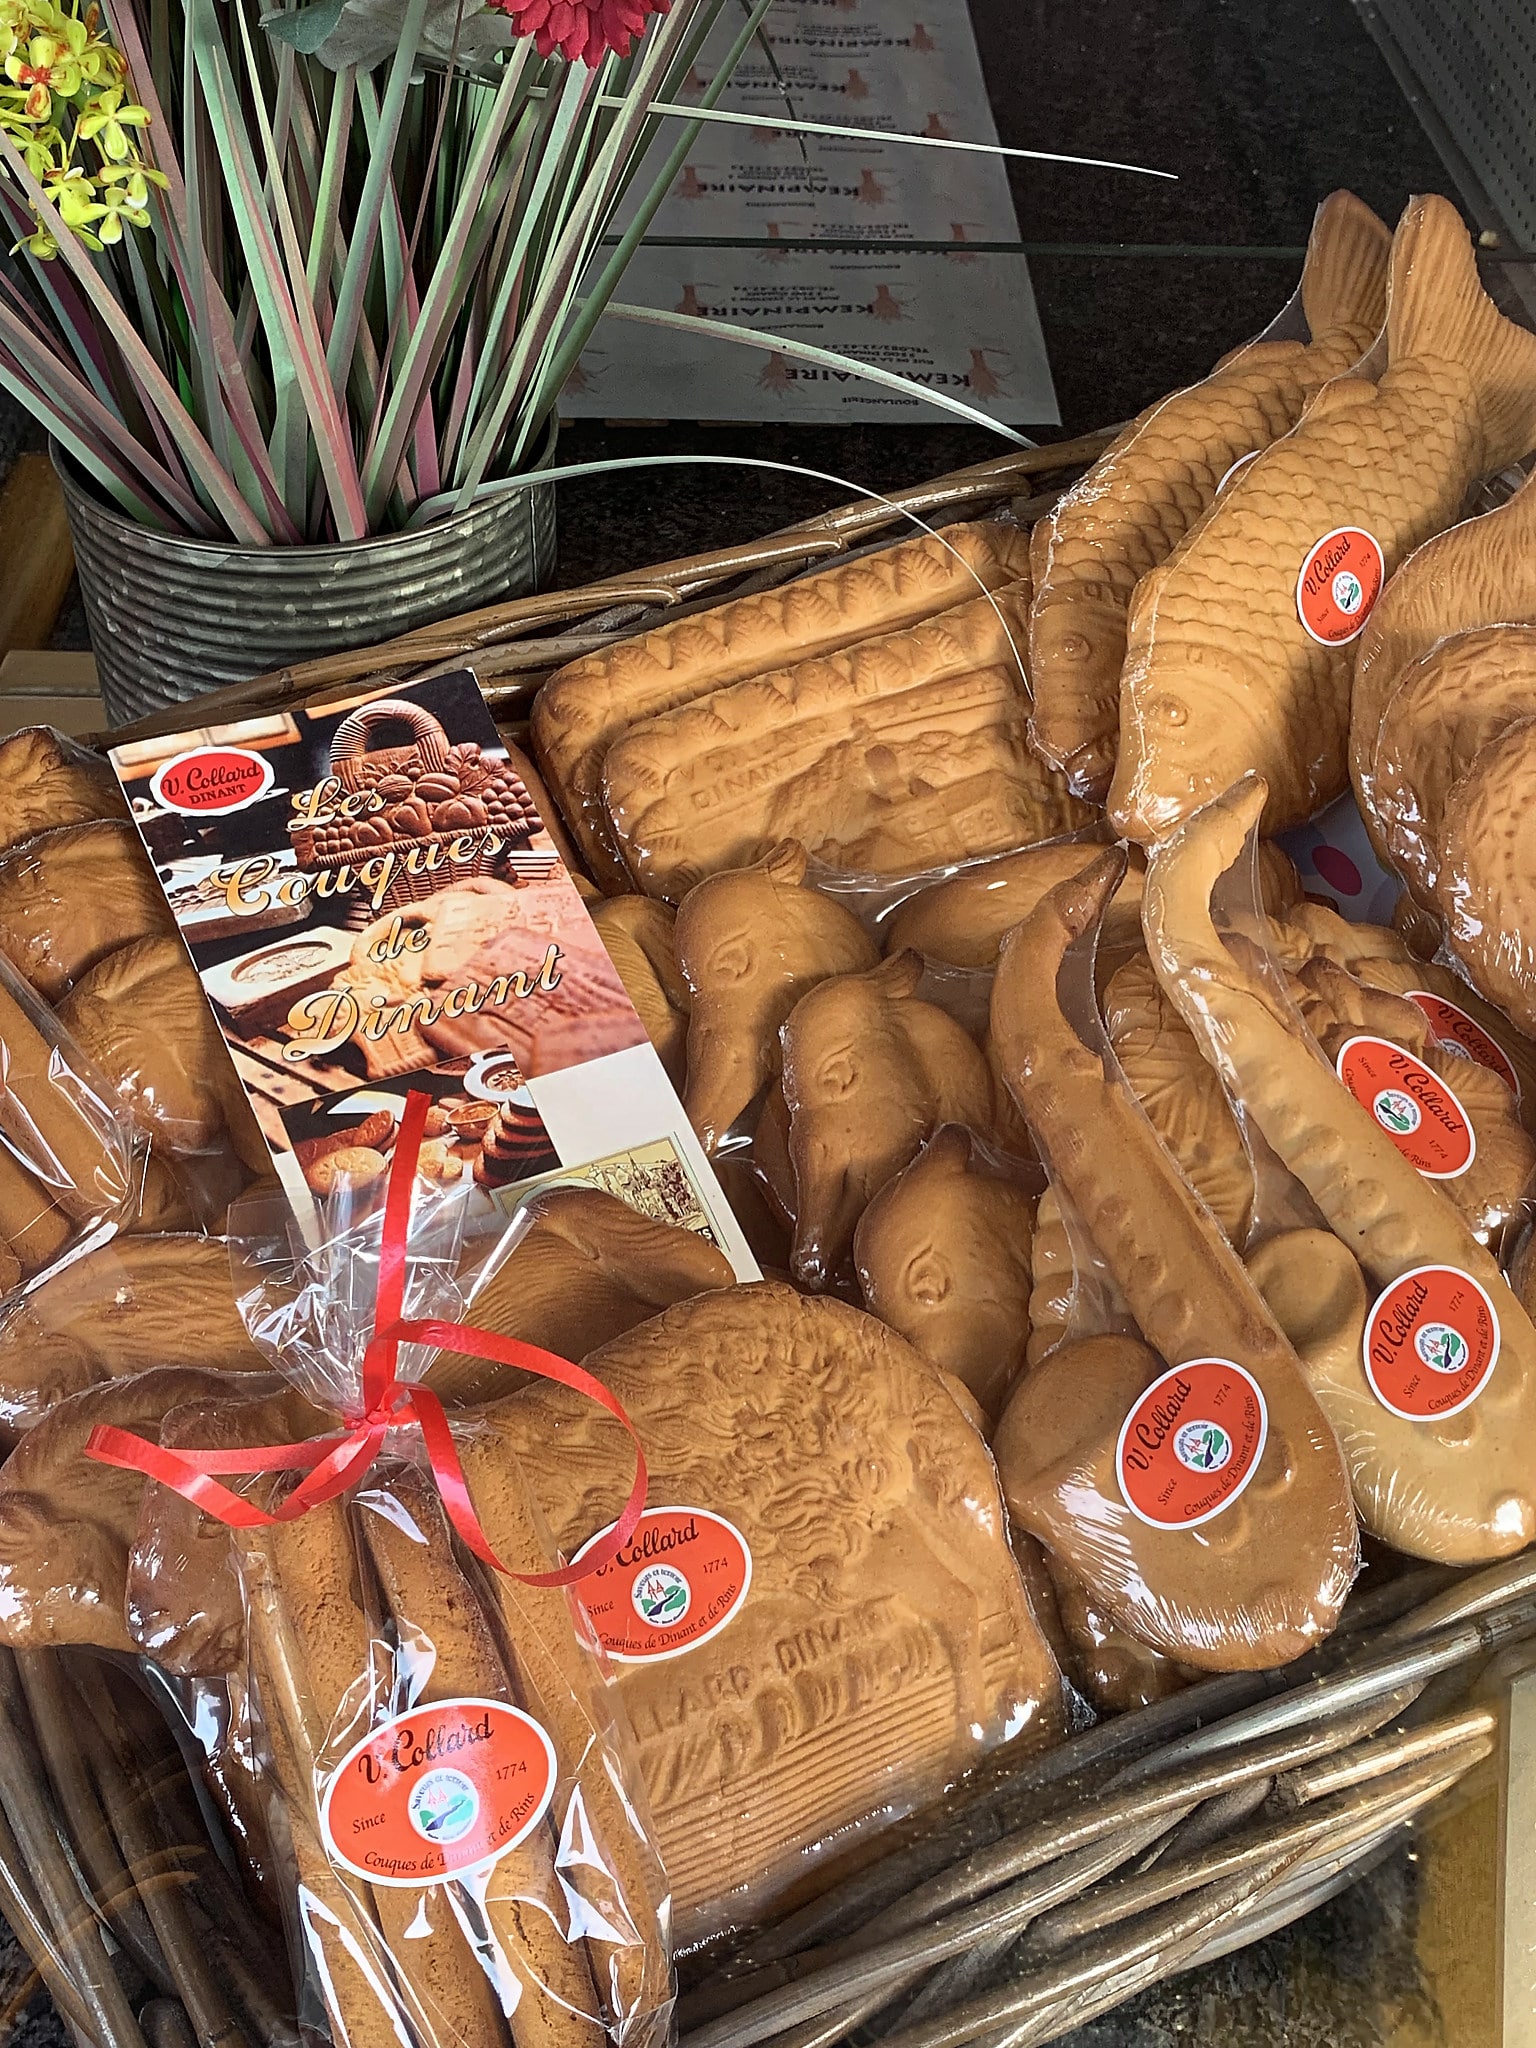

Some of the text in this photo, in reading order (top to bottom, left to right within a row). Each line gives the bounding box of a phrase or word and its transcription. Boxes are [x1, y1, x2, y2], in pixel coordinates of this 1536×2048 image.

[696, 305, 874, 317] KEMPINAIRE
[785, 368, 971, 387] KEMAIRE
[1313, 535, 1351, 584] Collard
[162, 761, 260, 796] V. Collard
[189, 784, 247, 804] DINANT
[287, 776, 387, 833] Les
[209, 825, 507, 915] Couques
[366, 914, 431, 964] de
[281, 943, 566, 1061] Dinant
[1358, 1057, 1377, 1078] Since
[1388, 1053, 1410, 1074] V.
[1403, 1072, 1464, 1133] Collard
[1429, 1140, 1449, 1159] 1774
[1449, 1290, 1465, 1312] 1774
[1373, 1280, 1429, 1365] V. Collard
[1475, 1305, 1489, 1330] Rins
[1466, 1350, 1487, 1382] Dinant
[1213, 1383, 1232, 1406] 1774
[1402, 1374, 1422, 1399] Since
[1461, 1375, 1470, 1392] de
[1243, 1395, 1256, 1421] Rins
[1428, 1388, 1462, 1411] Couques
[1126, 1377, 1192, 1471] V. Collard
[1241, 1420, 1256, 1433] de
[1228, 1444, 1250, 1479] Dinant
[1157, 1478, 1178, 1506] Since
[1221, 1477, 1232, 1491] de
[1184, 1490, 1222, 1516] Couques
[615, 1518, 700, 1567] Collard
[702, 1557, 728, 1574] 1774
[587, 1600, 615, 1618] Since
[600, 1632, 642, 1652] Couques
[644, 1633, 657, 1649] de
[658, 1622, 697, 1646] Dinant
[698, 1616, 708, 1628] et
[707, 1603, 719, 1620] de
[717, 1583, 738, 1612] Rins
[358, 1713, 495, 1784] V. Collard
[496, 1760, 528, 1781] 1774
[352, 1812, 387, 1834] Since
[364, 1850, 417, 1876] Couques
[420, 1851, 435, 1869] de
[498, 1815, 513, 1836] de
[510, 1792, 536, 1822] Rins
